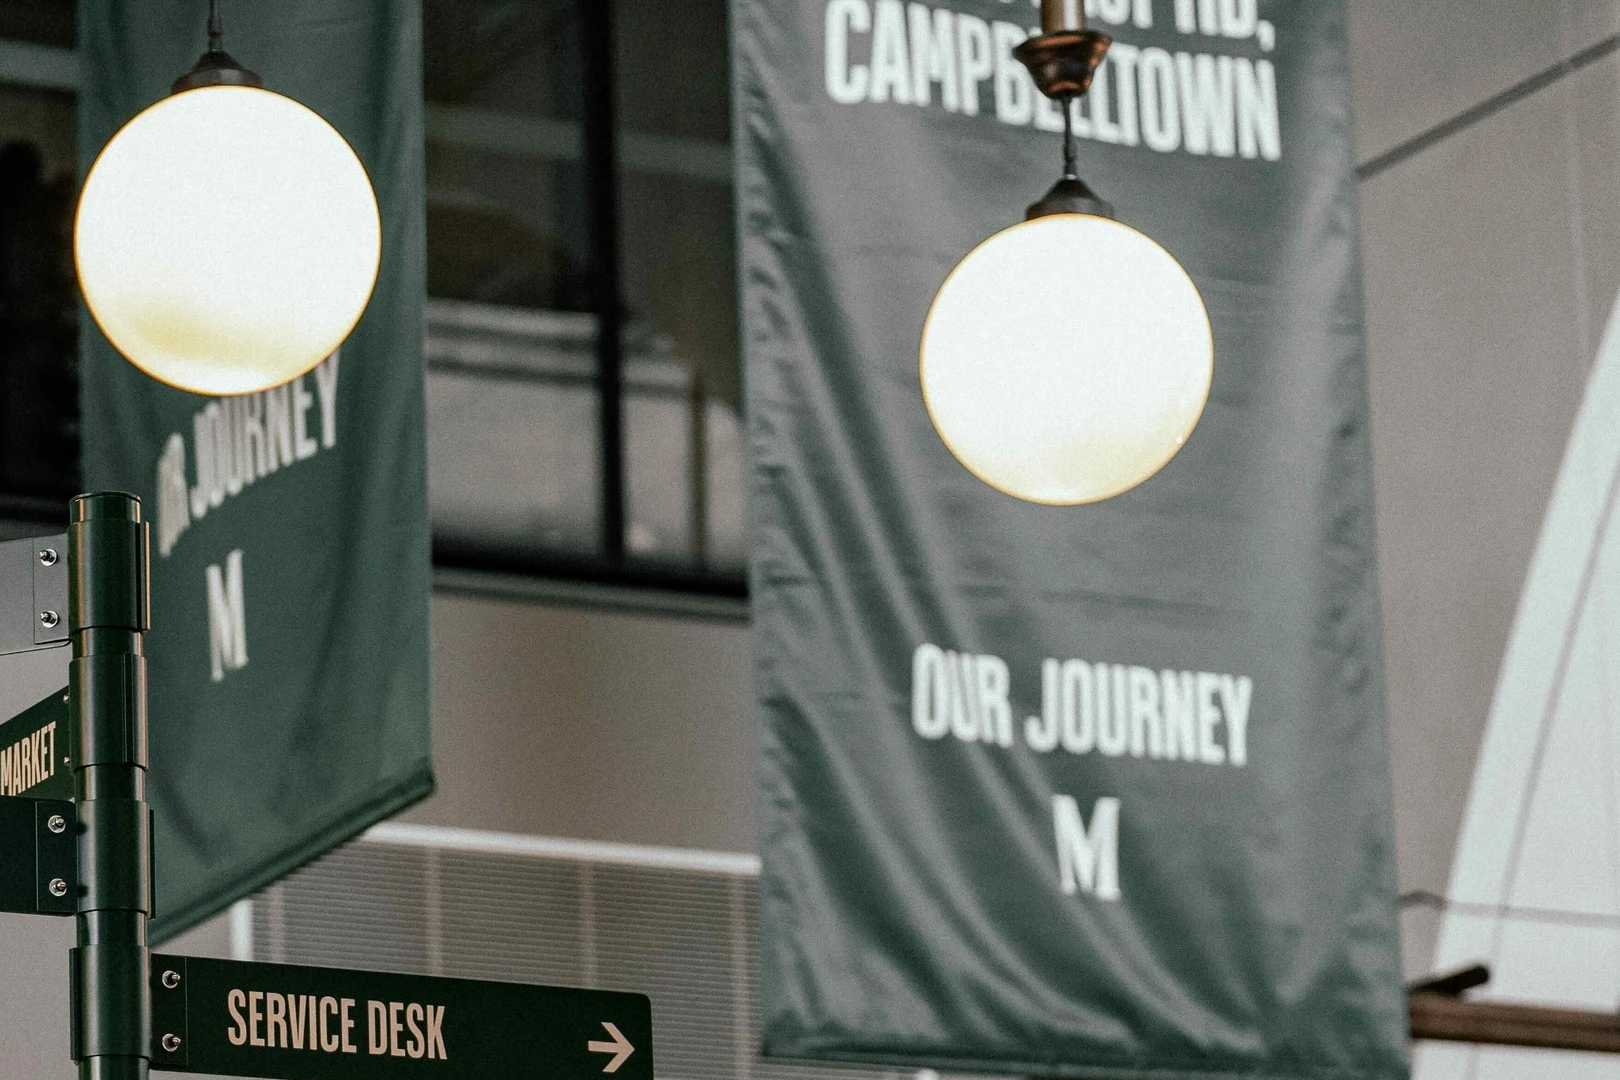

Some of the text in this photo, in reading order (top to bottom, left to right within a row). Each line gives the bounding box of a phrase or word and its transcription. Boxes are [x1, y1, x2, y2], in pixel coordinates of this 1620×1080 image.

[912, 642, 1254, 767] OUR JOURNEY
[0, 720, 57, 797] MARKET
[1052, 794, 1122, 900] M
[227, 988, 448, 1060] SERVICE DESK
